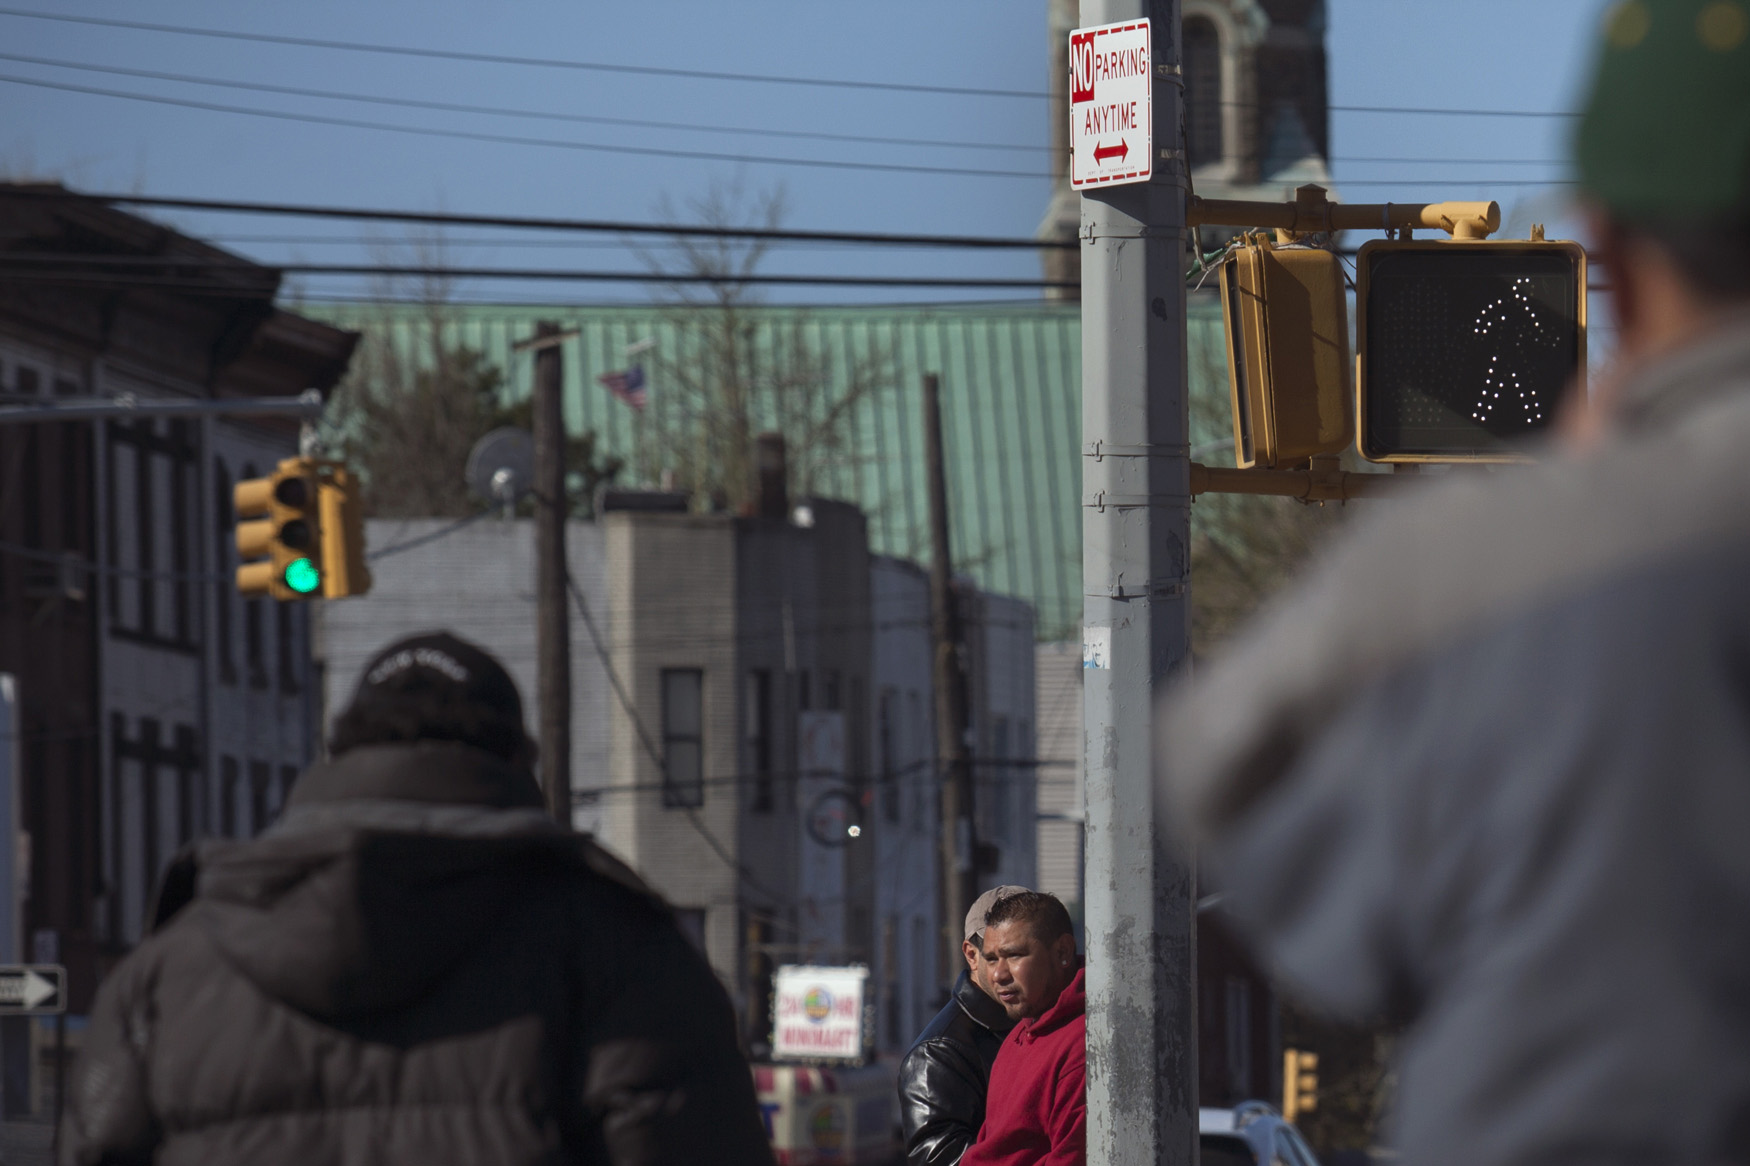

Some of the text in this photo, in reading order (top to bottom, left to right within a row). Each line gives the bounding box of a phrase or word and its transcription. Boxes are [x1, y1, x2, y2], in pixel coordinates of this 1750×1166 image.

[1073, 41, 1146, 93] NO PARKING
[1084, 101, 1137, 136] ANYTIME
